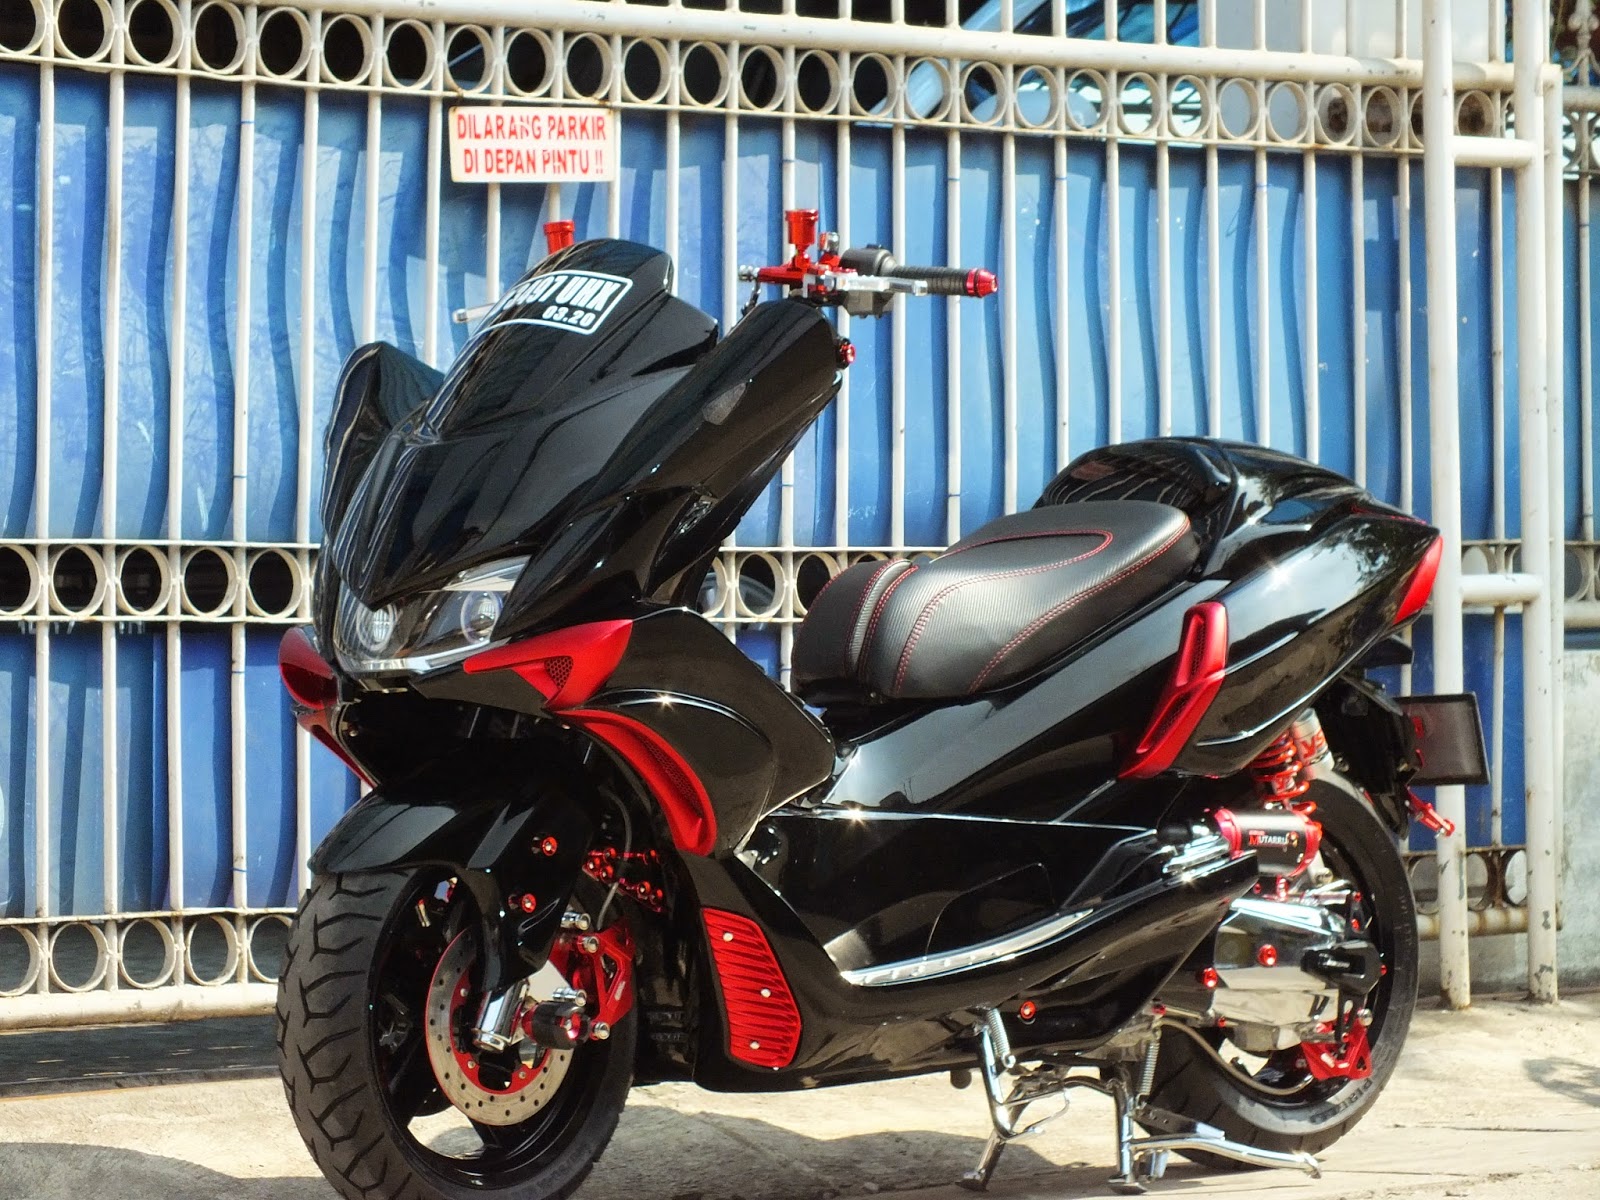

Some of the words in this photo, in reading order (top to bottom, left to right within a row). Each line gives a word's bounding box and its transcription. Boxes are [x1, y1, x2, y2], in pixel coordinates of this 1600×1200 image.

[457, 114, 542, 140] DILARANG
[548, 115, 607, 140] PARKIR
[464, 149, 479, 173] DI
[485, 149, 536, 174] DEPAN
[543, 150, 590, 174] PINTU
[542, 305, 596, 328] 03.20
